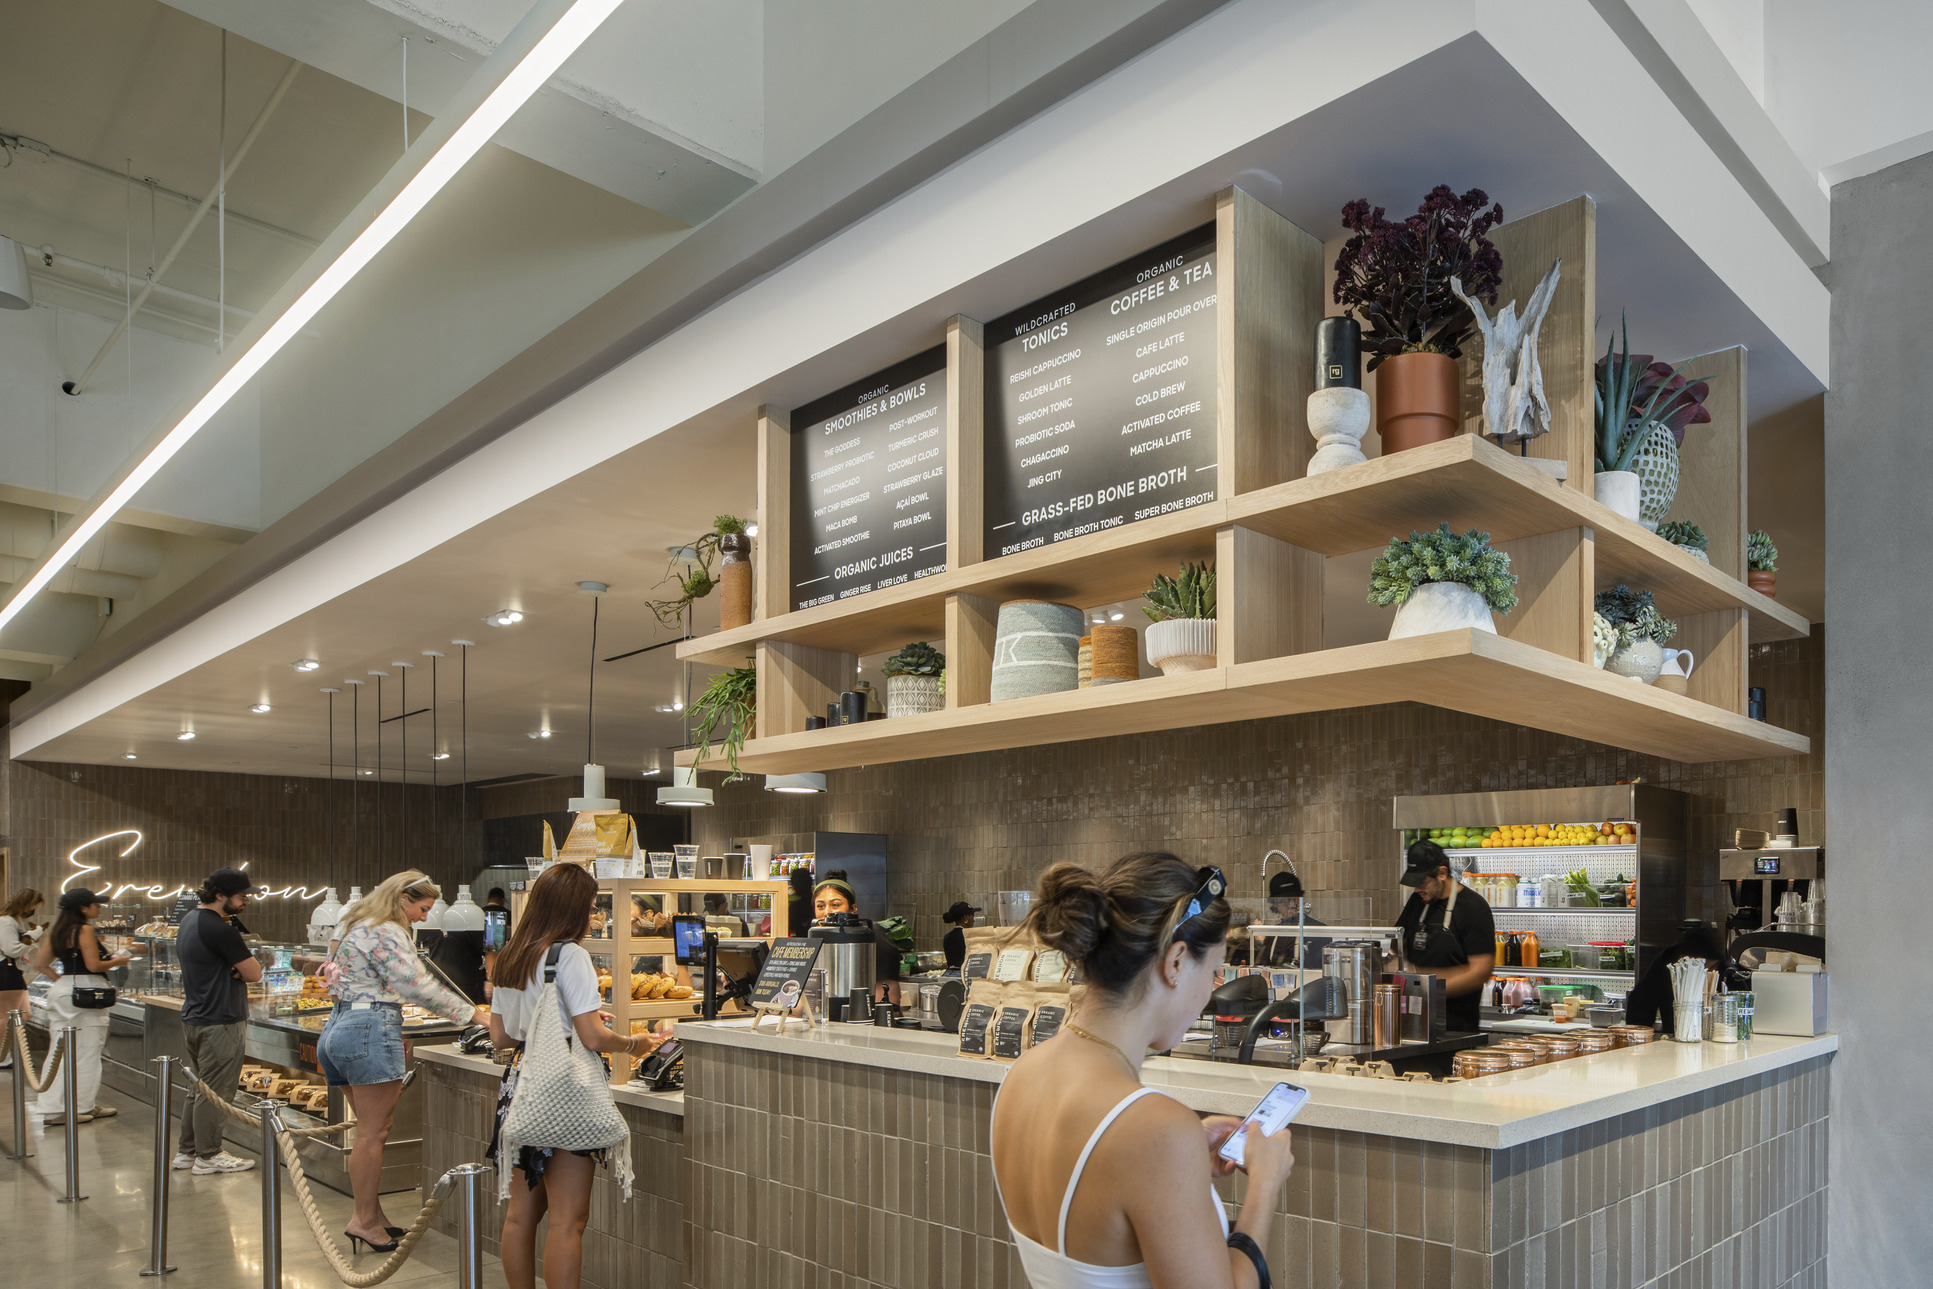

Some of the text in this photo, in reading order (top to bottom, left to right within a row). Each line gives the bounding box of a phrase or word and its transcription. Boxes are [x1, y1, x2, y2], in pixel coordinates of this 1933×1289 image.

[1136, 255, 1183, 283] ORGANIC
[1110, 261, 1212, 315] COFFEE & TEA
[1015, 302, 1076, 336] WILDCRAFTED
[1106, 294, 1217, 346] SINGLE ORIGIN POUR OVER
[1022, 322, 1068, 352] TONICS
[1136, 332, 1184, 358] CAFE LATTE
[1010, 349, 1081, 385] REISHI CAPPUCCINO
[1132, 355, 1189, 383] CAPPUCCINO
[857, 384, 889, 404] ORGANIC
[1018, 375, 1071, 403] GOLDEN LATTE
[1135, 381, 1186, 407] COLD BREW
[825, 383, 926, 435] SMOOTHIES & BOWLS
[889, 406, 938, 432] POST-WORKOUT
[1017, 397, 1073, 425] SHROOM TONIC
[1121, 401, 1201, 436] ACTIVATED COFFEE
[888, 427, 939, 452] TURMERIC CRUSH
[1015, 420, 1075, 448] PROBIOTIC SODA
[1130, 429, 1191, 457] MATCHA LATTE
[824, 437, 861, 458] THE GODDESS
[887, 447, 939, 472] COCONUT CLOUD
[1020, 444, 1069, 468] CHAGACCINO
[810, 451, 875, 482] STRAWBERRY PROBIOTIC
[1027, 469, 1063, 489] JING CITY
[823, 476, 860, 495] MATCHACADO
[883, 466, 943, 494] STRAWBERRY GLAZE
[814, 492, 870, 518] MINT CHIP ENERGIZER
[896, 492, 929, 510] AÇAÍ BOWL
[1022, 465, 1187, 526] GRASS-FED BONE BROTH
[1134, 491, 1214, 521] SUPER BONE BROTH
[826, 515, 858, 532] MACA BOMB
[893, 512, 932, 531] PITAYA BOWL
[1054, 515, 1123, 542] BONE BROTH TONIC
[814, 531, 870, 555] ACTIVATED SMOOTHIE
[1002, 536, 1044, 556] BONE BROTH
[834, 546, 913, 579] ORGANIC JUICES
[914, 563, 947, 579] HEALTHWO
[840, 583, 872, 599] GINGER RISE
[878, 573, 908, 589] LIVER LOVE
[799, 594, 835, 610] THE BIG GREEN
[61, 830, 329, 900] Ereon
